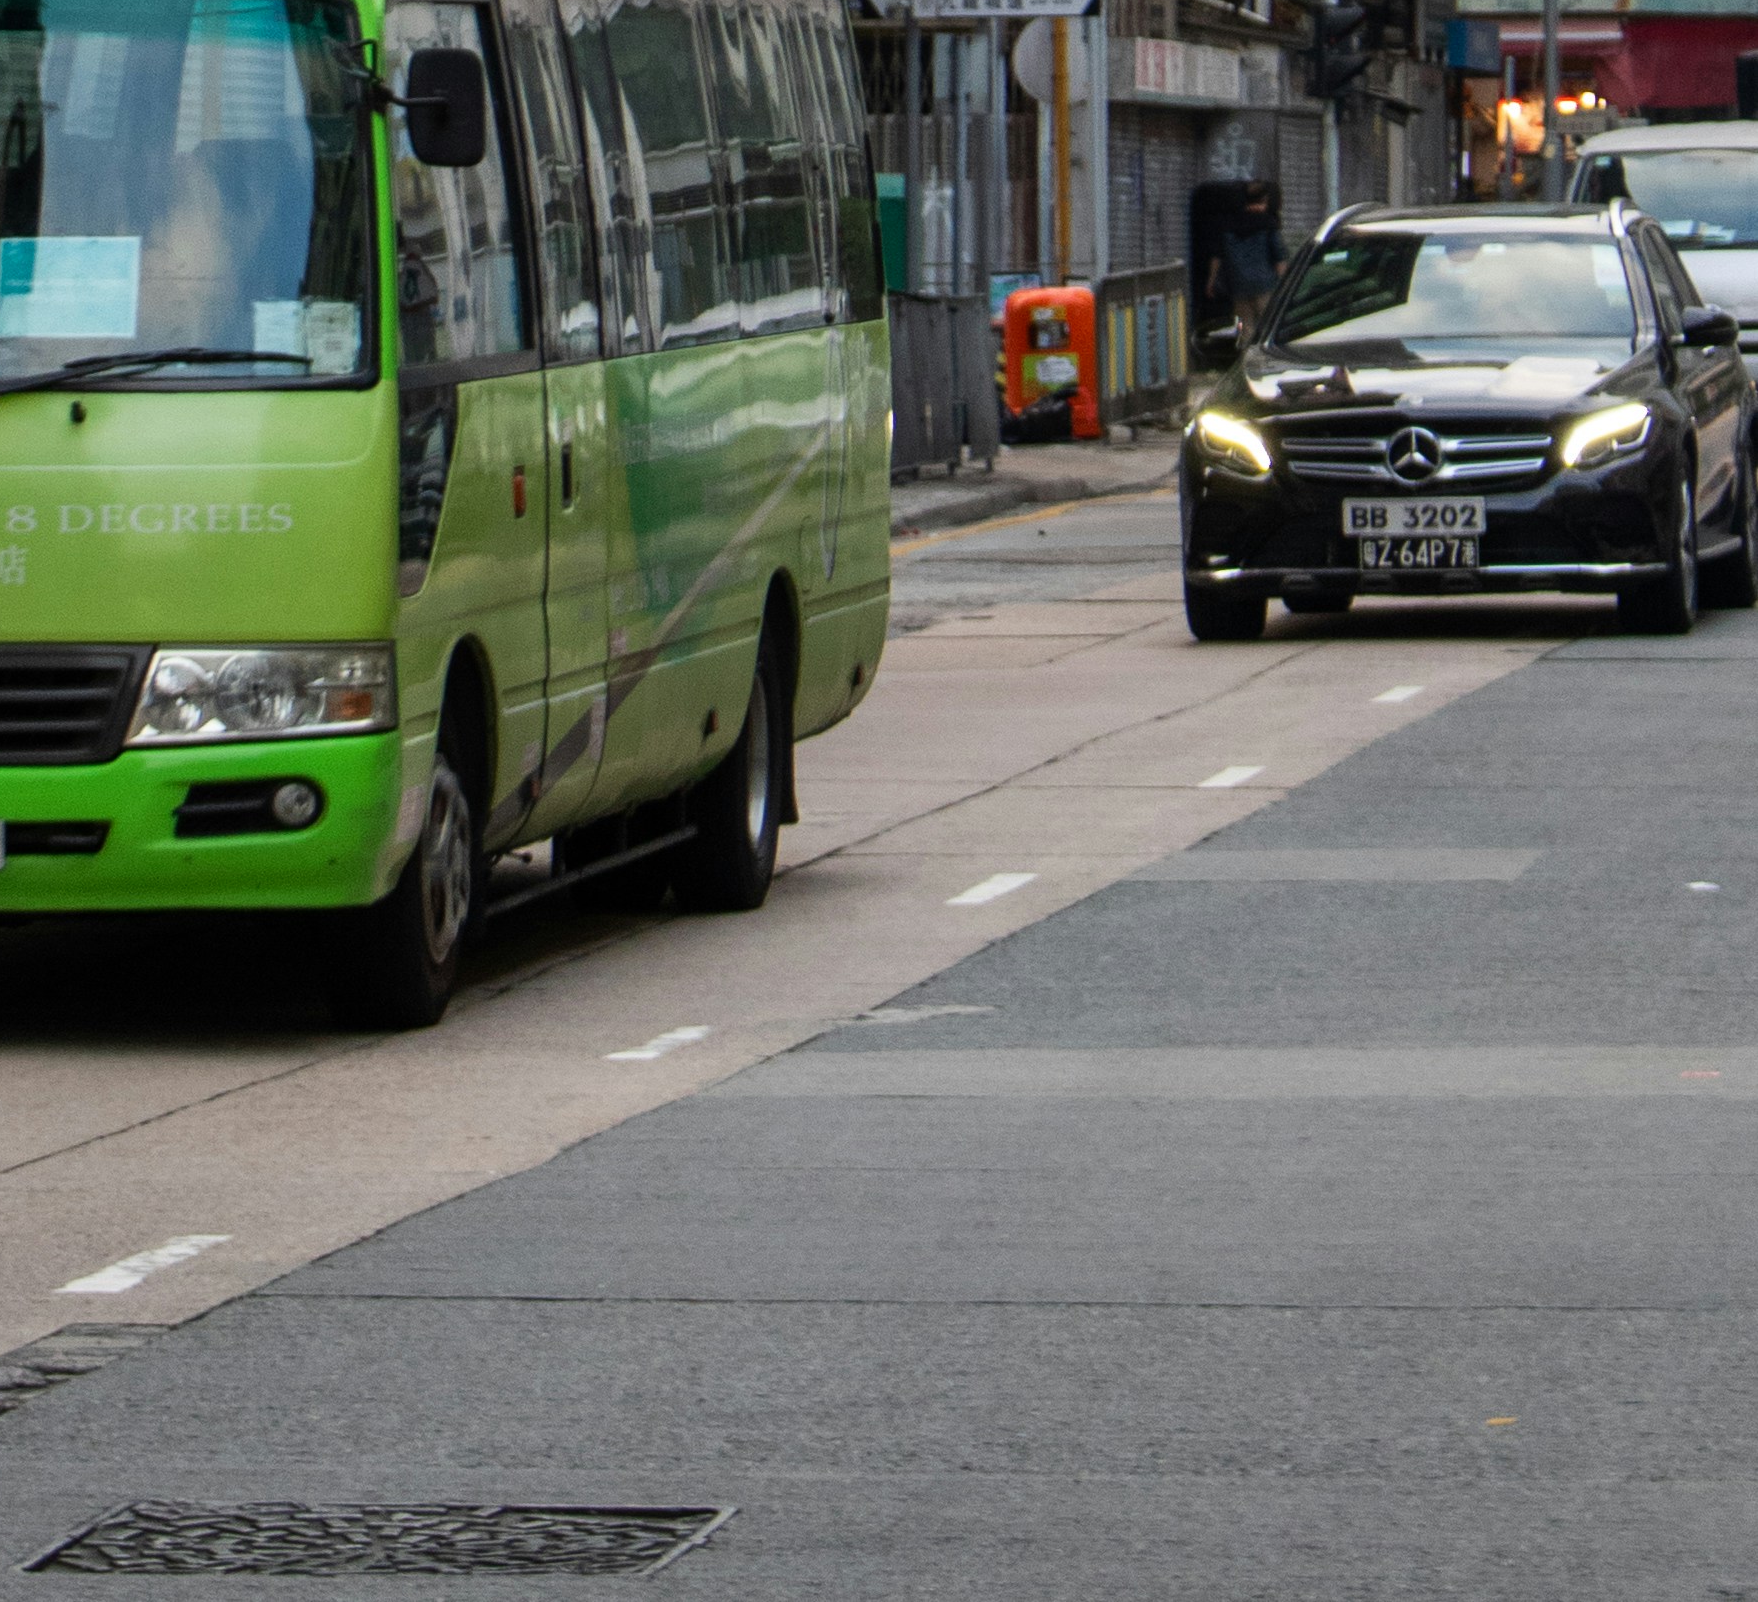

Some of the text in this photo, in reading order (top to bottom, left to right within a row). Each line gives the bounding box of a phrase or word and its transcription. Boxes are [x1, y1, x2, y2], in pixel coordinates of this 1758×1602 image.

[5, 505, 39, 534] 8
[58, 503, 295, 534] DEGREES
[1350, 505, 1478, 529] BB 3202
